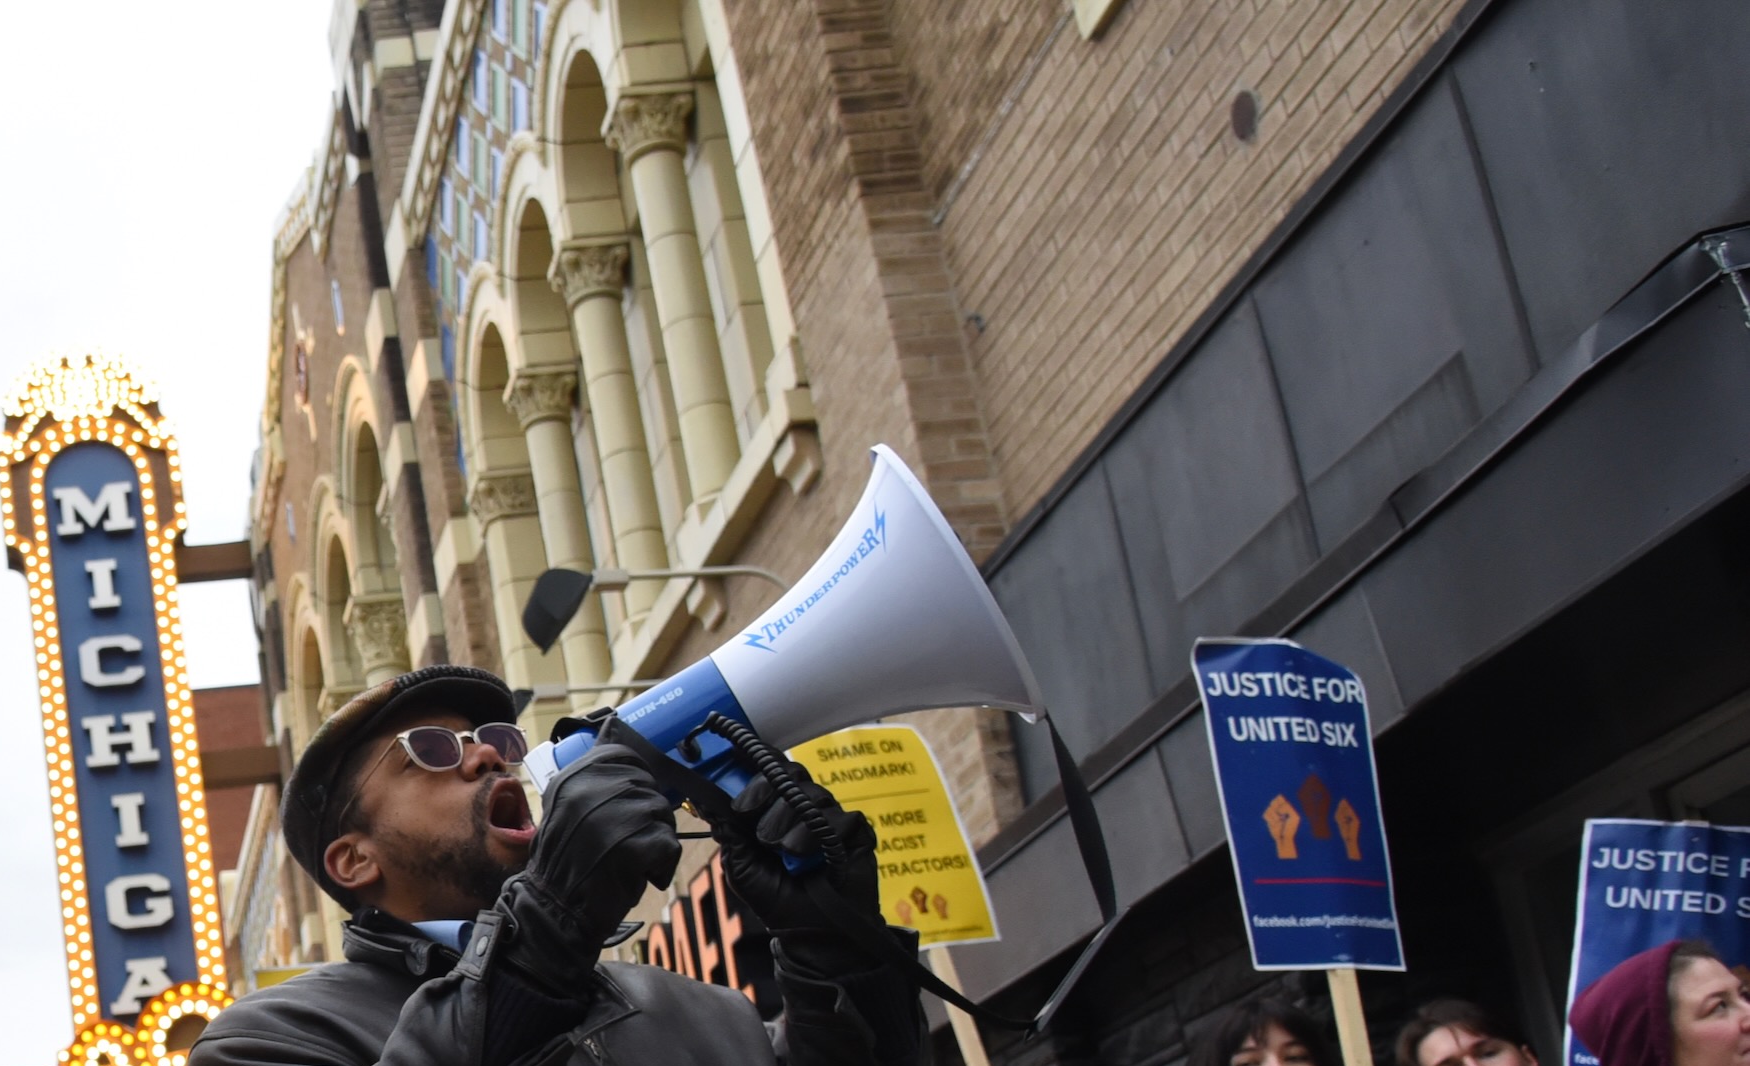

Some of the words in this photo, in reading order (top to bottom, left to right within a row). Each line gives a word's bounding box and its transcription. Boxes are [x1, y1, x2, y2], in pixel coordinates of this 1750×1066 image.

[1206, 671, 1311, 700] JUSTICE
[1311, 676, 1364, 704] FOR
[1227, 715, 1320, 742] UNITED
[1320, 720, 1359, 749] SIX
[53, 481, 174, 1015] MICHIGA
[816, 741, 877, 762] SHAME
[878, 739, 904, 755] ON
[818, 762, 915, 786] LANDMARK!
[878, 808, 928, 827] MORE
[875, 834, 927, 855] ACIST
[878, 854, 970, 880] TRACTORS!
[1591, 846, 1730, 878] JUSTICE
[1605, 885, 1727, 915] UNITED
